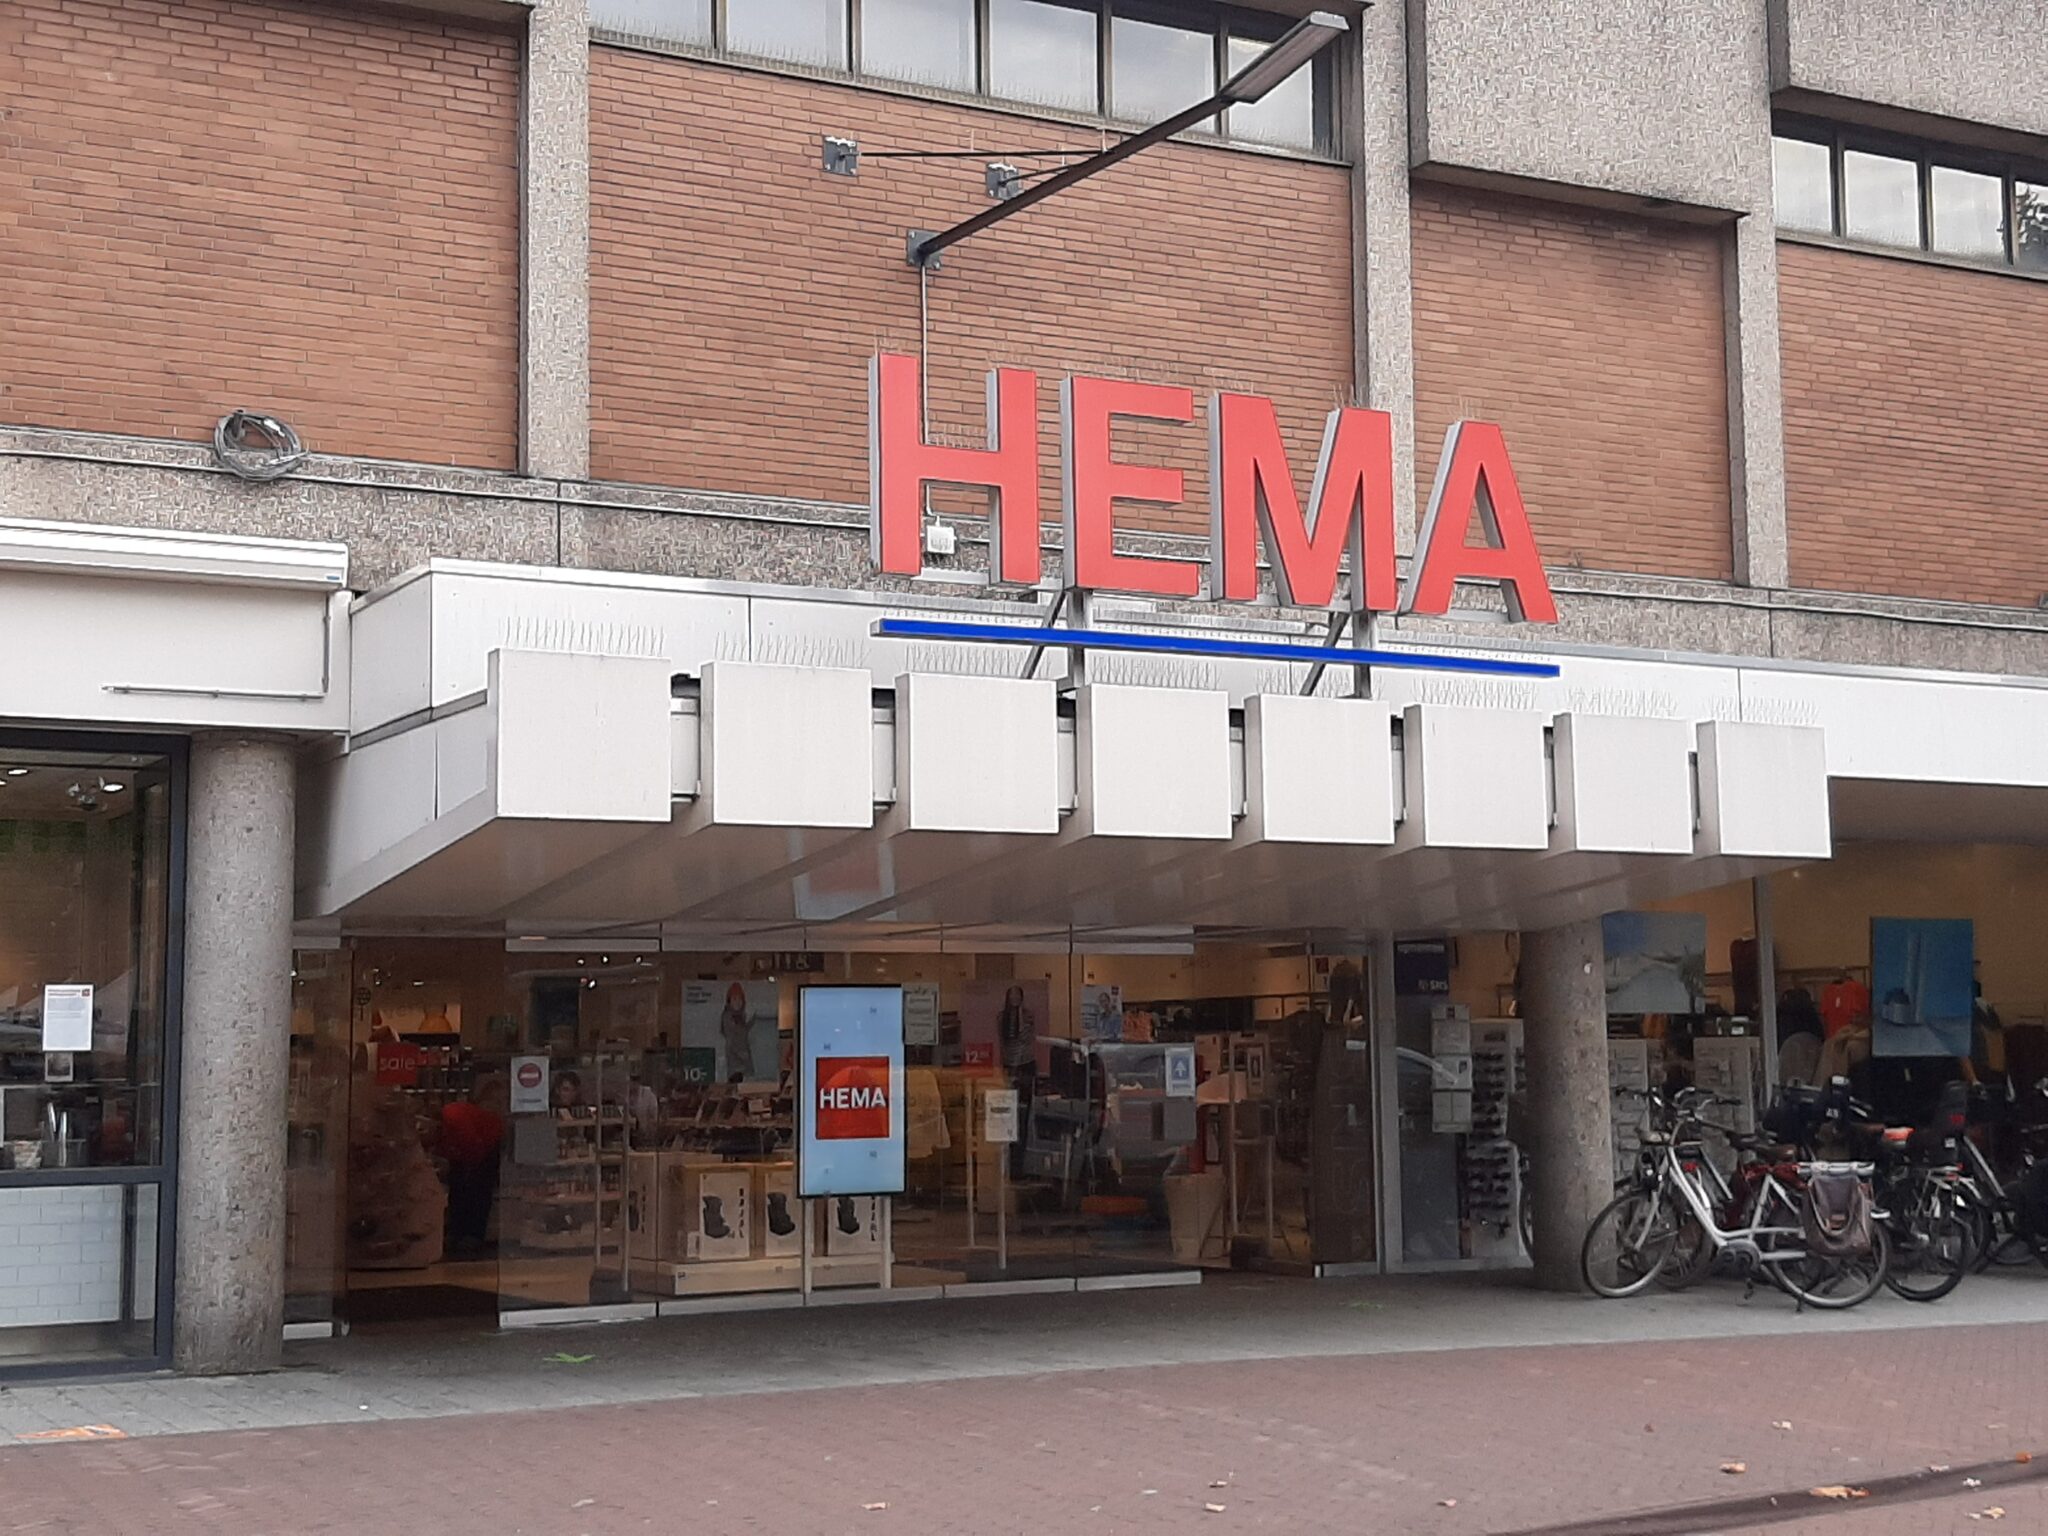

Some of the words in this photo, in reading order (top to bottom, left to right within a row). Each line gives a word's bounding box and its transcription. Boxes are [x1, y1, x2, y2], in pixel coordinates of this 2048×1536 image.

[870, 354, 1558, 623] HEMA
[379, 1056, 416, 1071] sale
[819, 1087, 887, 1110] HEMA
